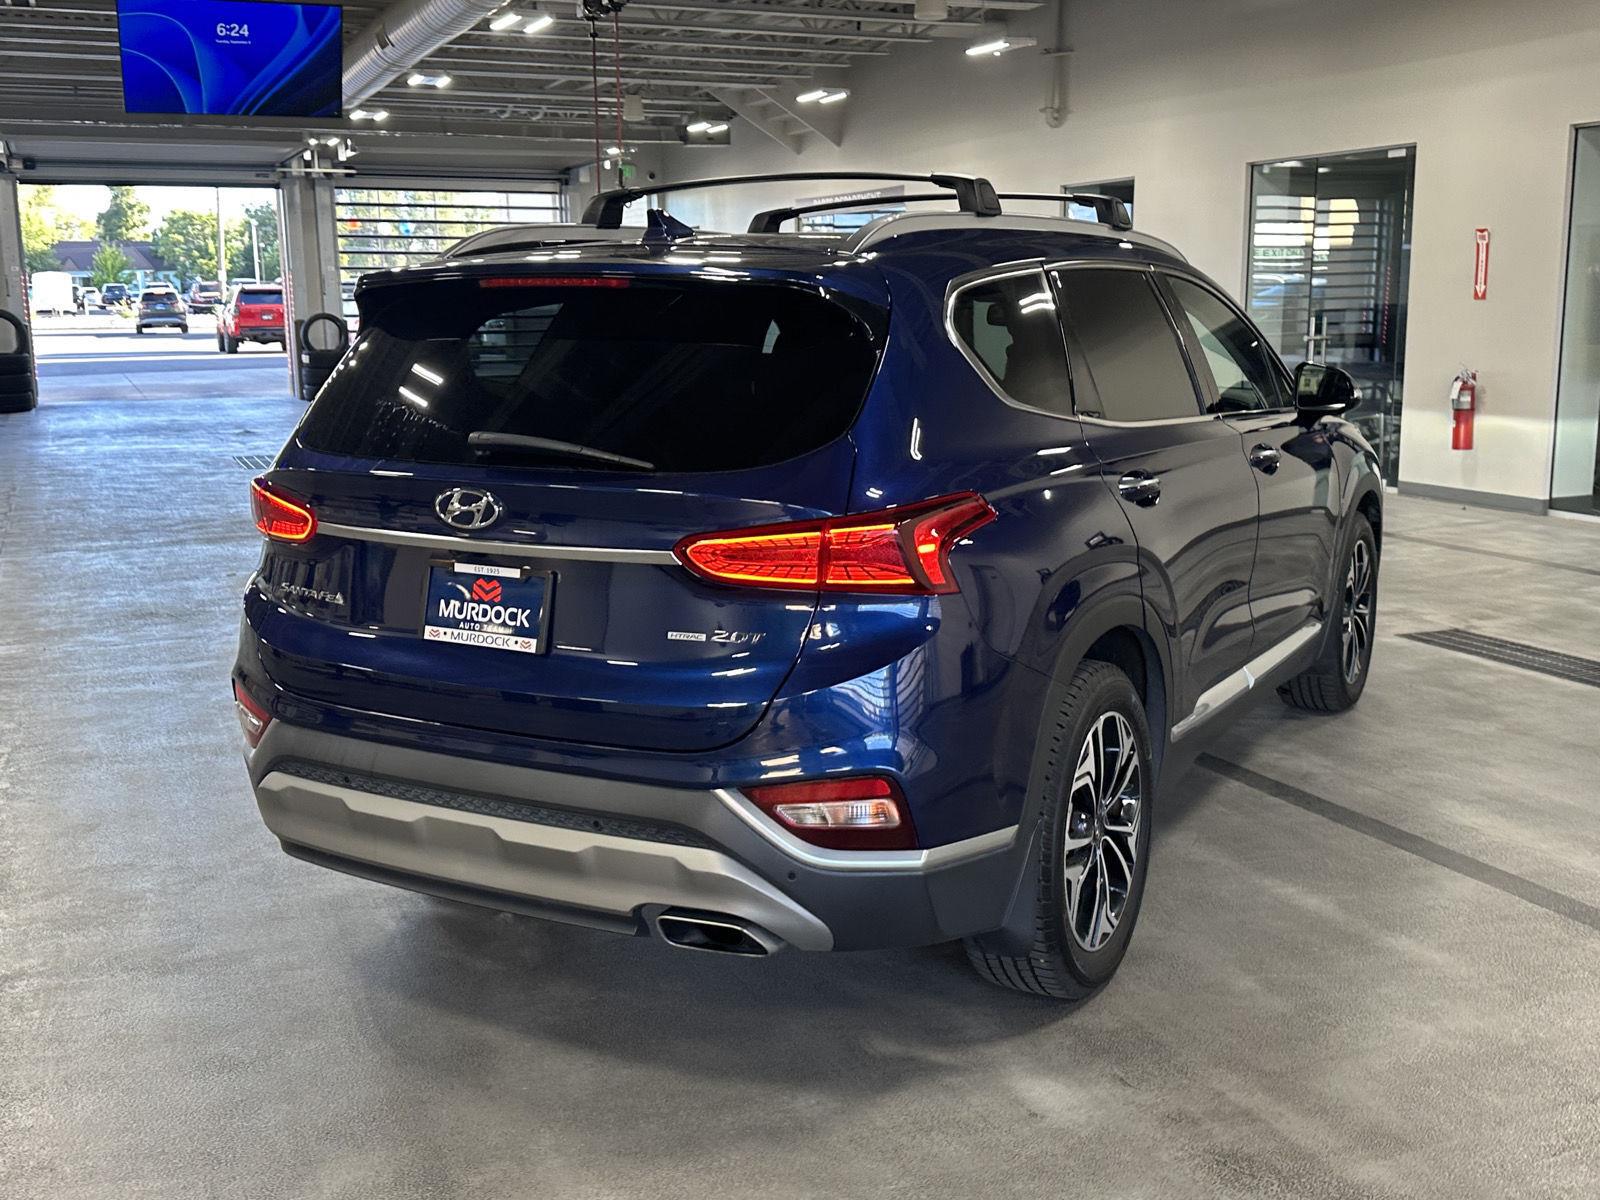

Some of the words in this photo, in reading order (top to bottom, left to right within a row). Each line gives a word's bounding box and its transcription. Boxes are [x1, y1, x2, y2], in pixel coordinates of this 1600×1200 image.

[216, 22, 249, 37] 6:24
[438, 598, 531, 628] MURDOCK
[459, 621, 480, 631] AUTO
[450, 631, 511, 648] MURDOCK
[670, 633, 704, 641] HTRAC
